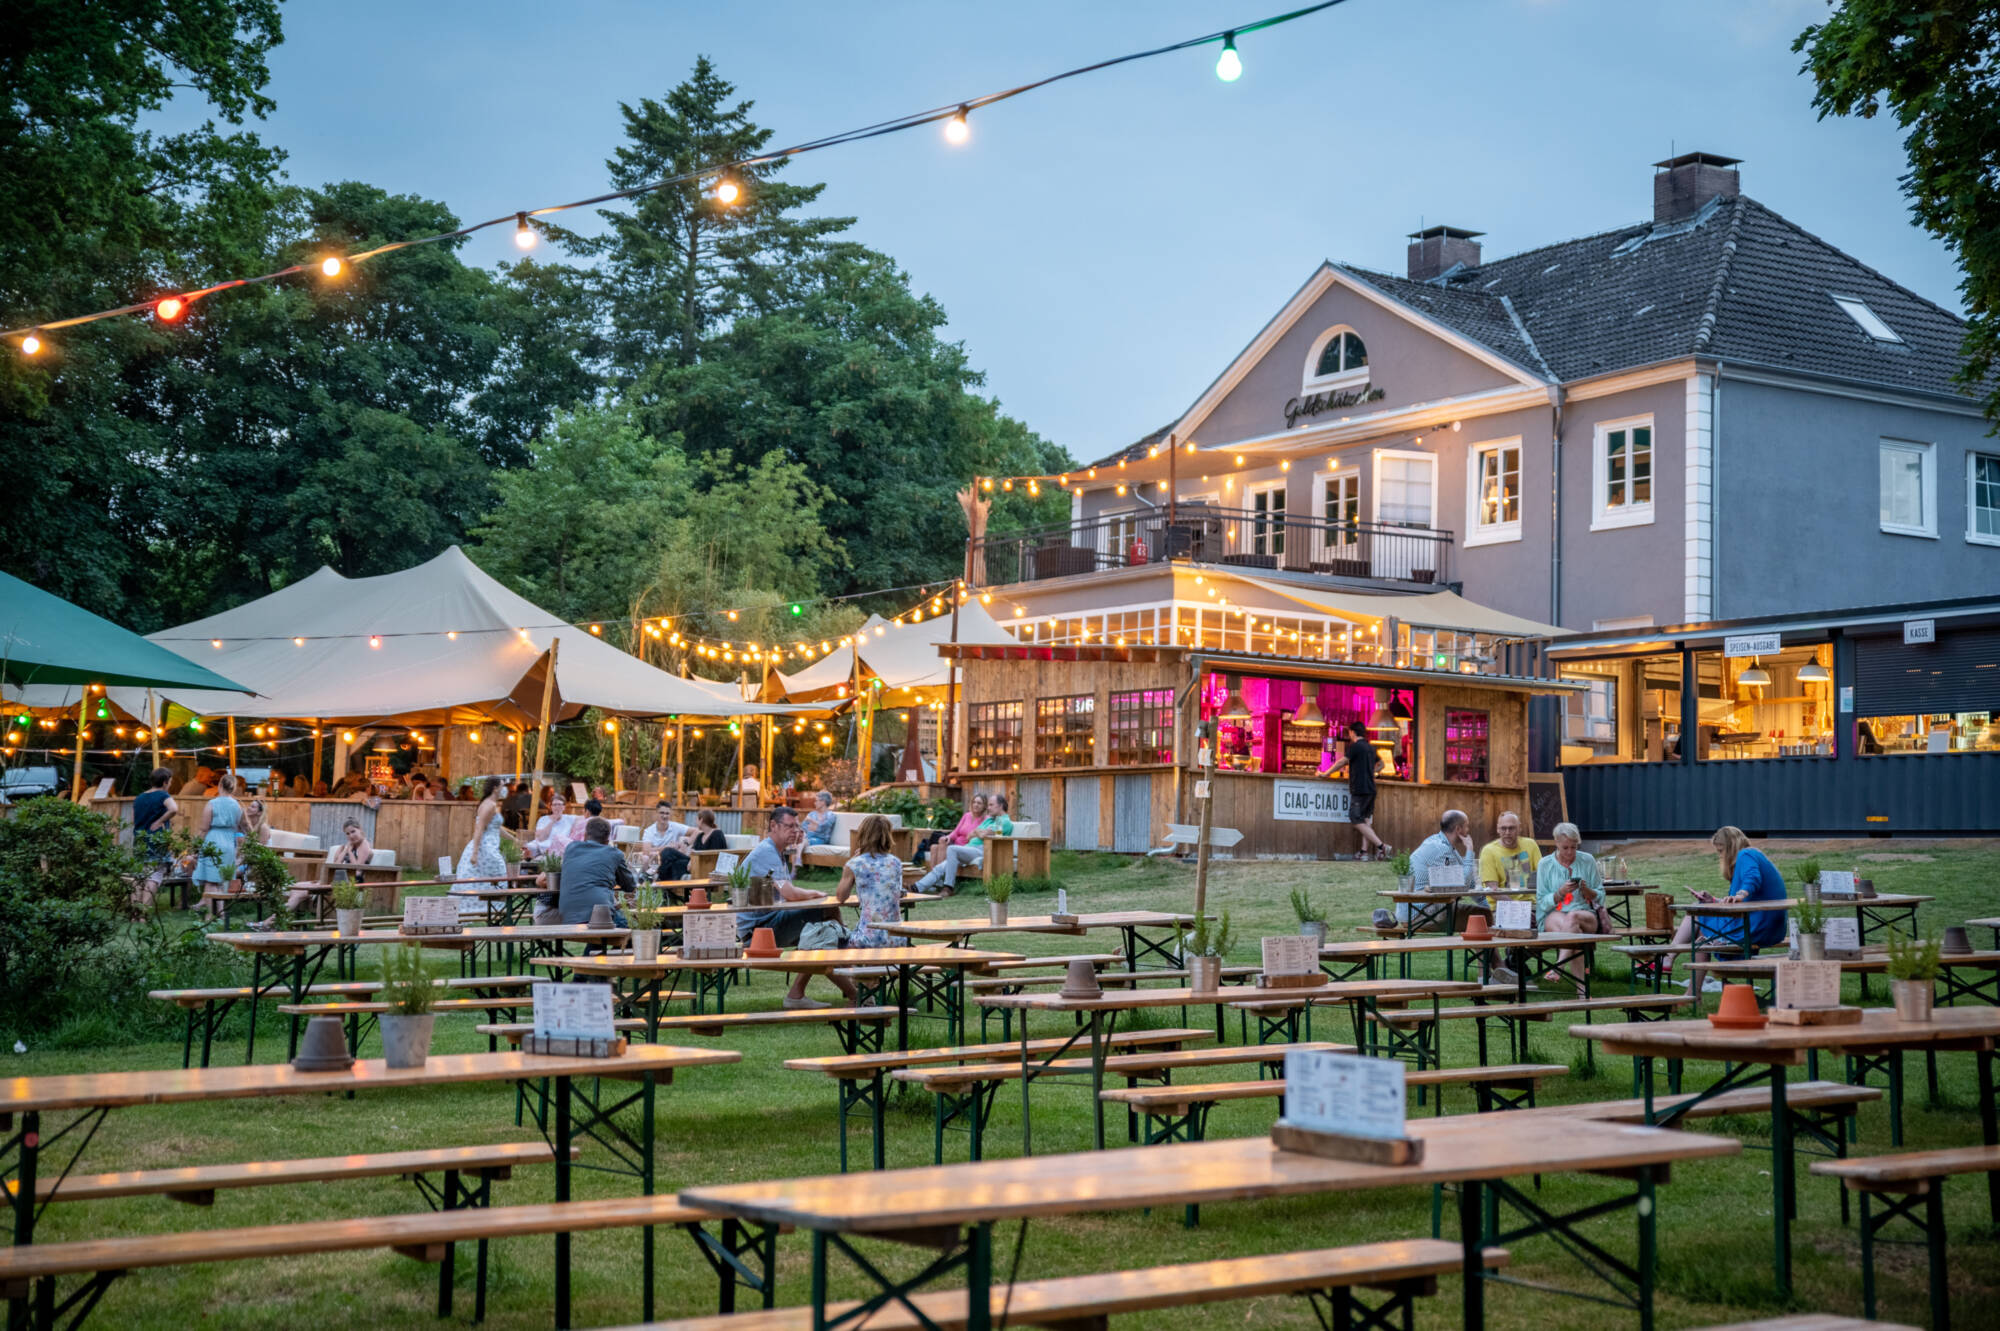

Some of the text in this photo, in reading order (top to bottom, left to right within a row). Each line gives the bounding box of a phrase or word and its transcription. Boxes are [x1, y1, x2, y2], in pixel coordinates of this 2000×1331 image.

[1910, 628, 1929, 638] KASSE
[1729, 641, 1776, 652] SPEISEN-AUSGABE
[1285, 792, 1338, 811] CIAO-CIAO
